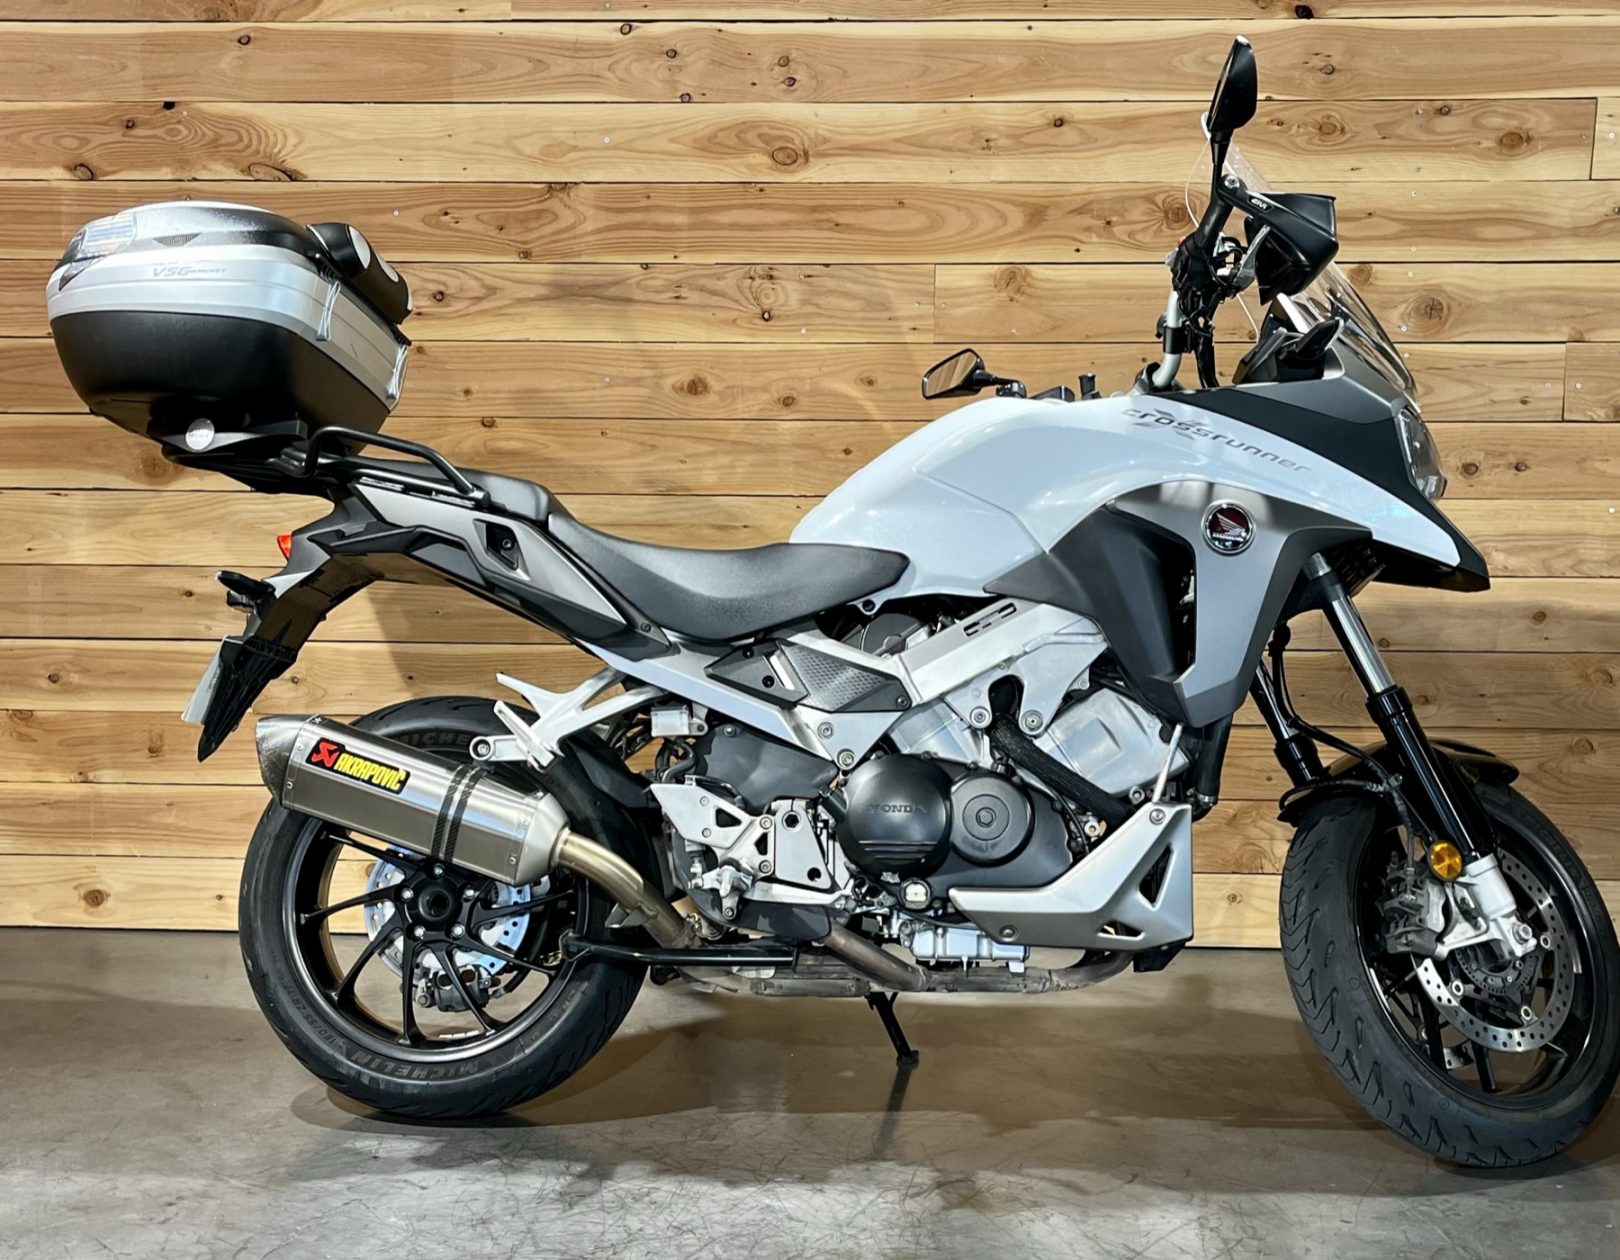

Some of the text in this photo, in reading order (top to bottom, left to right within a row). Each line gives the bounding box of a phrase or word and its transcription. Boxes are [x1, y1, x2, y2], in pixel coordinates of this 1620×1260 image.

[1121, 408, 1312, 472] crossrunner
[868, 803, 928, 815] HONDA
[350, 1050, 479, 1080] MICHELIN
